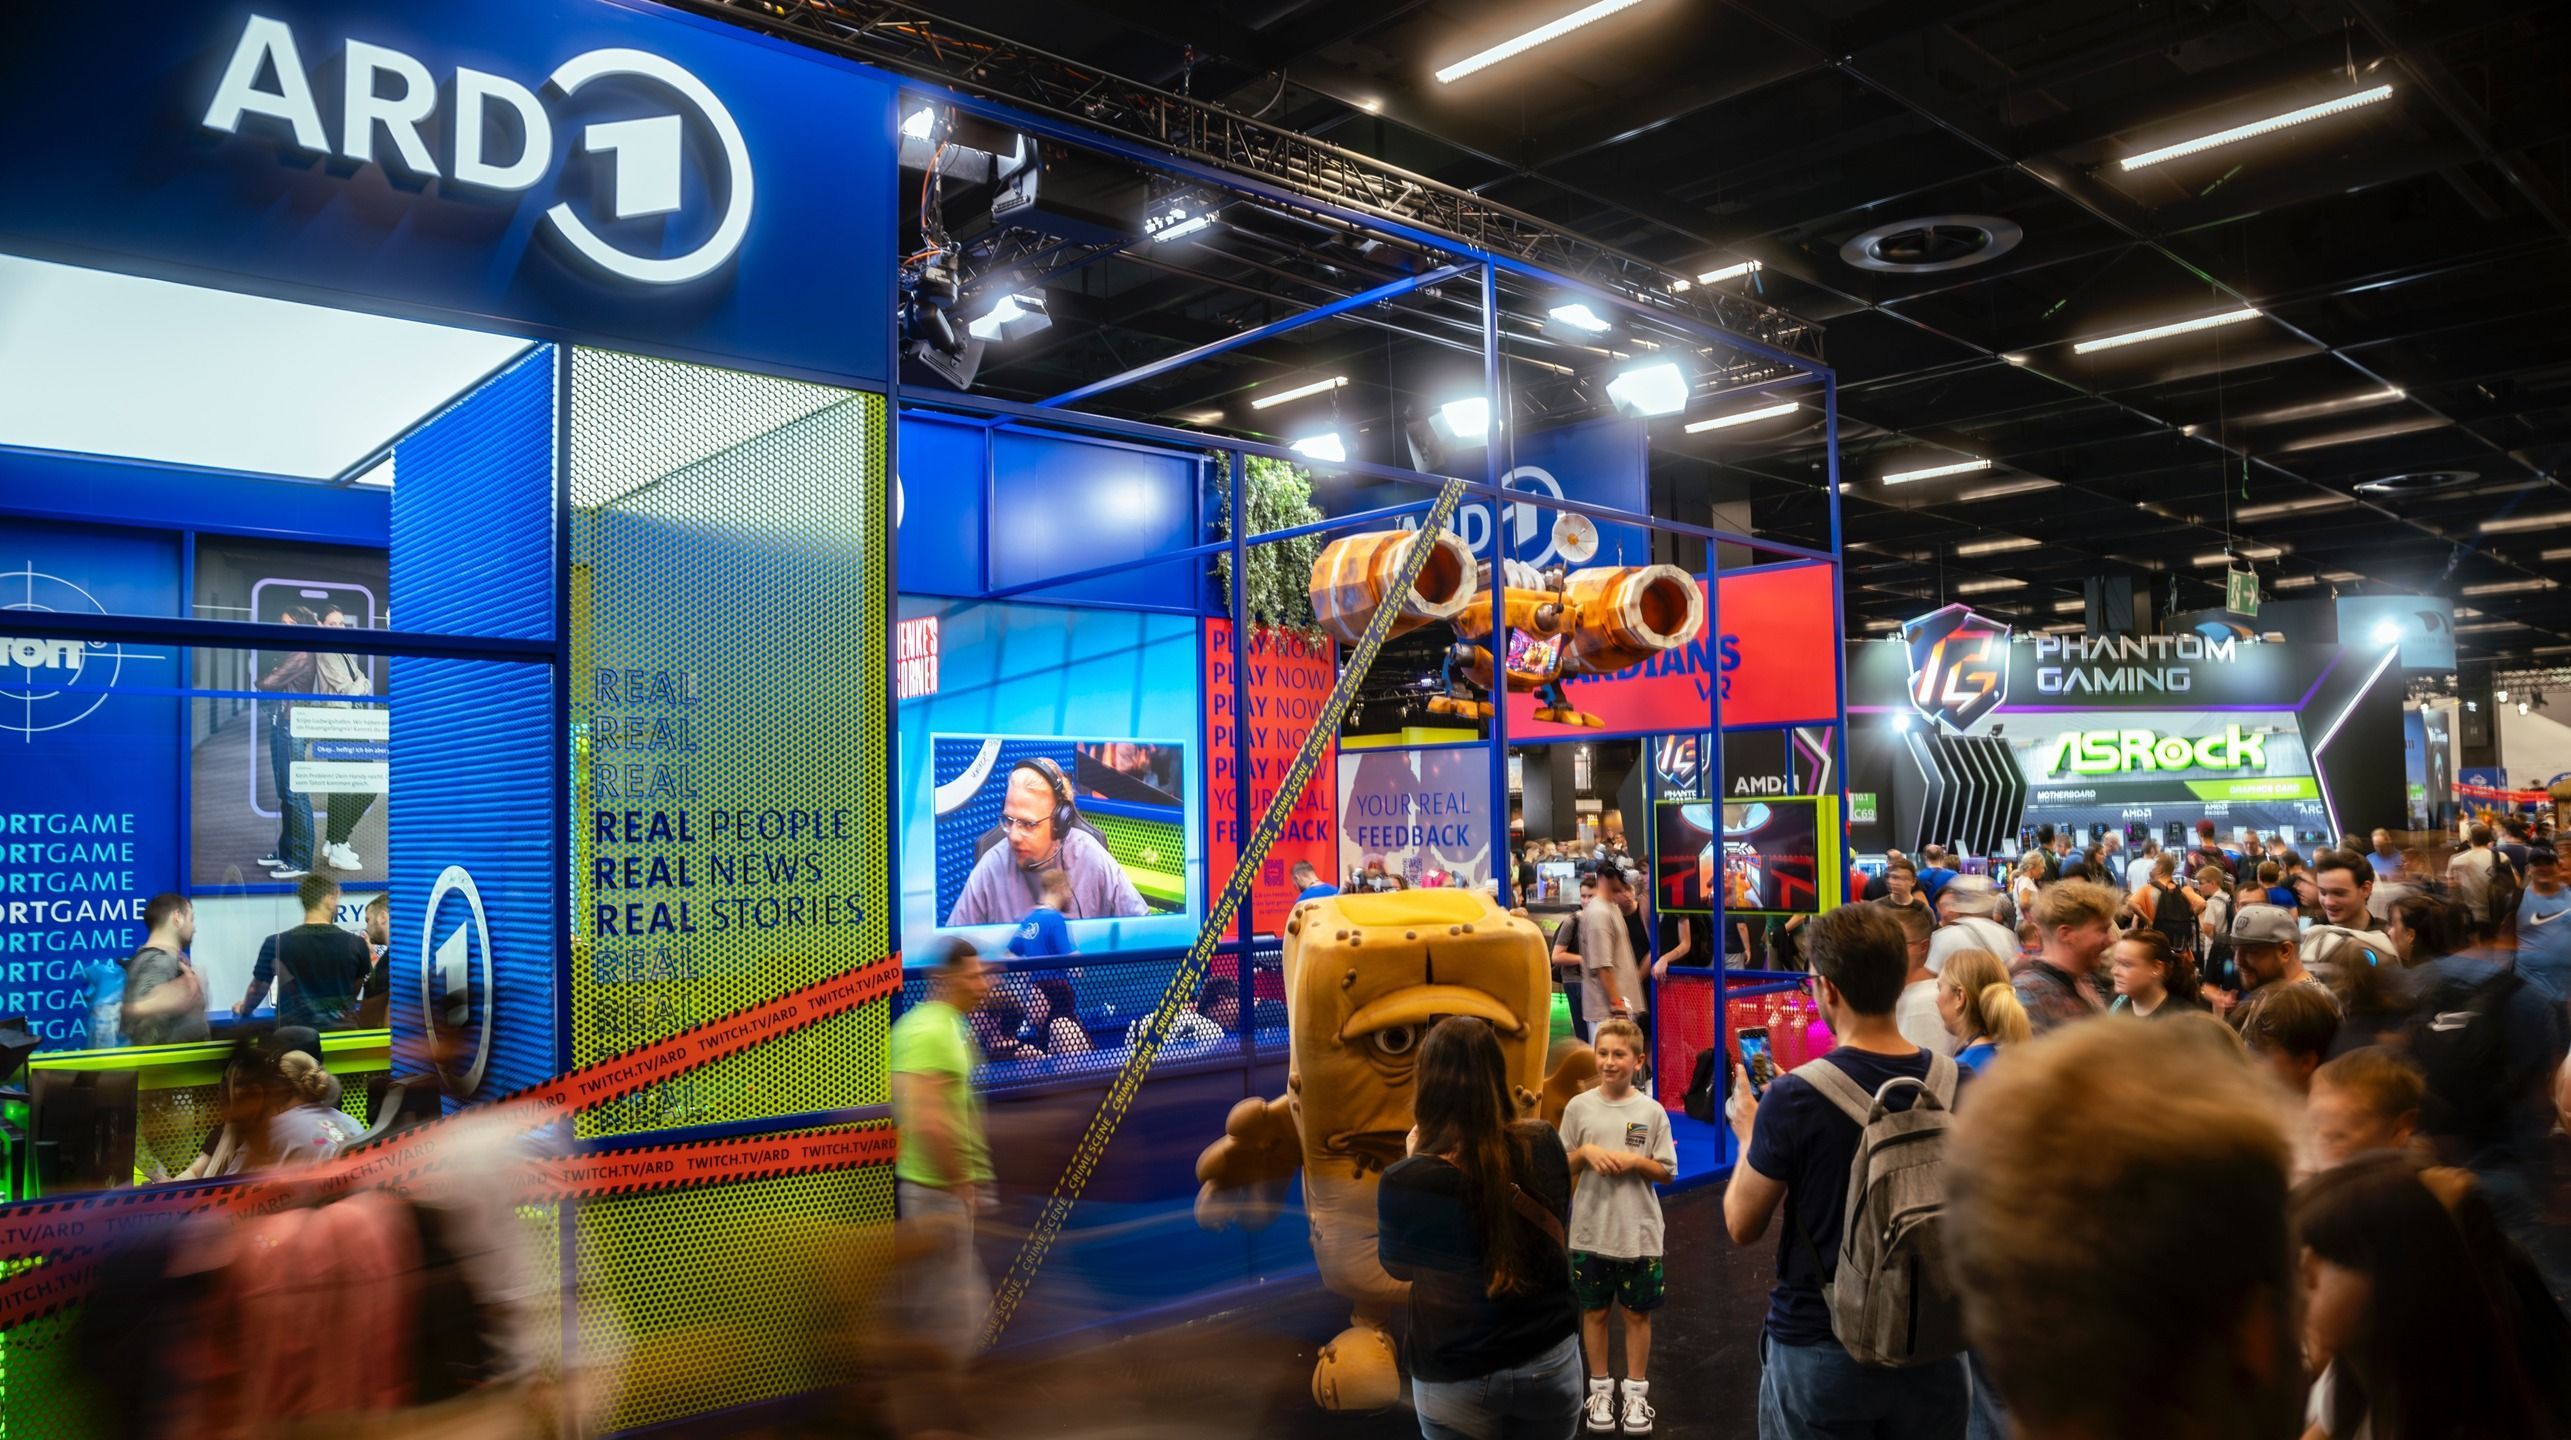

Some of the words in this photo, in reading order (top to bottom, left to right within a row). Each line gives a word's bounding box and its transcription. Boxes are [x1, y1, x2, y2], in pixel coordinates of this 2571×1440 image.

[202, 13, 553, 191] ARD
[1376, 606, 1393, 634] CRIME
[1214, 630, 1267, 656] PLY
[2036, 635, 2236, 663] PHANTOM
[1276, 666, 1327, 691] NOW
[1343, 665, 1361, 694] CRIME
[1358, 638, 1377, 667] SCENE
[2037, 667, 2191, 695] GAMING
[595, 668, 698, 706] REAL
[1276, 696, 1324, 721] NOW
[595, 715, 698, 751] REAL
[1277, 728, 1314, 750] NO
[1308, 728, 1327, 758] CRIME
[1324, 699, 1344, 729] SCENE
[2048, 723, 2266, 776] ASRock
[595, 763, 698, 798] REAL
[1277, 758, 1328, 782] NW
[1734, 776, 1782, 794] AMD
[1272, 790, 1292, 823] CRIME
[1289, 761, 1310, 793] SCENE
[1357, 794, 1412, 817] YOUR
[1420, 792, 1471, 816] REAL
[1664, 789, 1706, 798] PHANTO
[2037, 789, 2097, 802] MOTHERBOARD
[595, 809, 697, 843] REAL
[710, 808, 851, 841] PEOPLE
[1855, 808, 1875, 818] C69
[2122, 808, 2144, 819] AMD
[1358, 823, 1470, 848] FEEDBACK
[595, 856, 697, 890] REAL
[710, 851, 823, 886] NEWS
[1234, 858, 1255, 891] CRIME
[1252, 827, 1273, 859] SCENE
[0, 898, 146, 924] RTGAME
[597, 901, 698, 938] REAL
[711, 893, 864, 932] STORIES
[1195, 929, 1217, 961] CRIME
[1213, 895, 1235, 929] SCENE
[0, 928, 134, 953] RTGAME
[596, 945, 699, 985] REAL
[596, 993, 701, 1035] REAL
[1155, 1001, 1177, 1035] CRIME
[1173, 966, 1196, 1002] SCENE
[578, 1047, 687, 1096] TWITCH.TV/ARD
[698, 1005, 798, 1052] TWITCH.TV/ARD
[807, 966, 900, 1010] TWITCH.TV/ARD
[1112, 1075, 1135, 1111] CRIME
[1132, 1040, 1155, 1076] SCENE
[562, 1159, 675, 1183] TWITCH.TV/ARD
[687, 1147, 790, 1171] TWITCH.TV/ARD
[801, 1137, 897, 1160] TWITCH.TV/ARD
[1068, 1152, 1092, 1190] CRIME
[1088, 1116, 1112, 1153] SCENE
[1021, 1233, 1047, 1271] CRIME
[1043, 1196, 1067, 1234] SCENE
[996, 1279, 1021, 1317] SCENE
